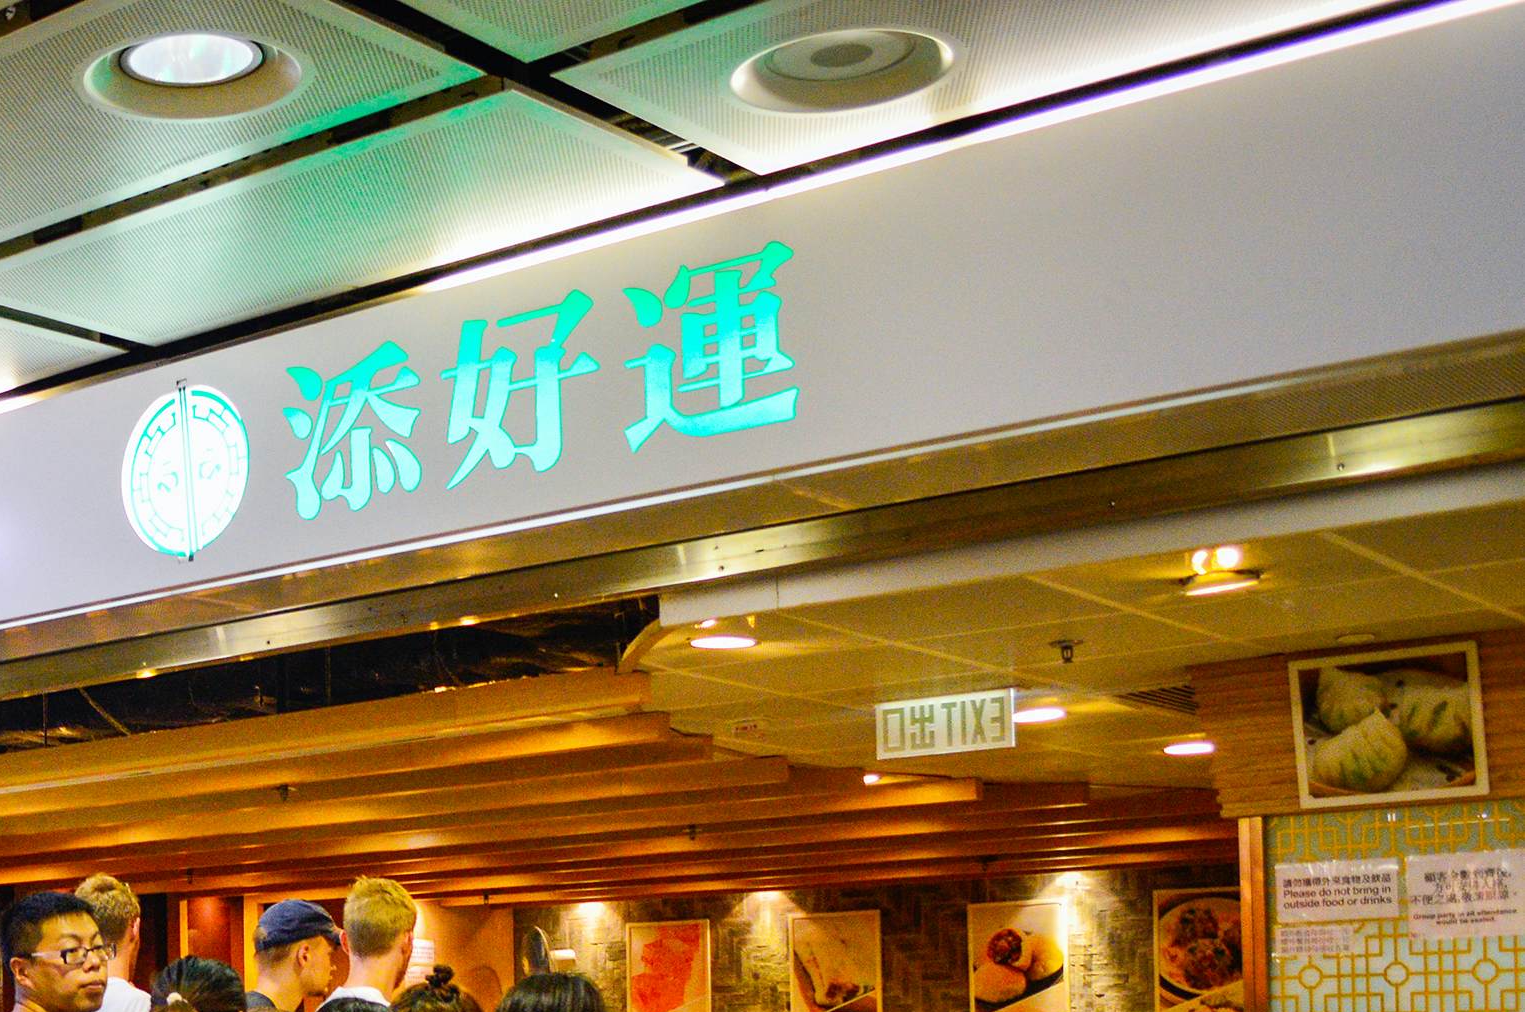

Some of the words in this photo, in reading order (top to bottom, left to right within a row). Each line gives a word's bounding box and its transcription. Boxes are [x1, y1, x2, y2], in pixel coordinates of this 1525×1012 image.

[282, 240, 799, 521] 添好運
[1283, 890, 1316, 899] Please
[1319, 888, 1332, 897] do
[1334, 887, 1351, 897] not
[1353, 887, 1379, 897] bring
[1382, 886, 1391, 894] in
[1283, 899, 1320, 909] outside
[1322, 898, 1344, 908] food
[1360, 896, 1393, 905] drinks
